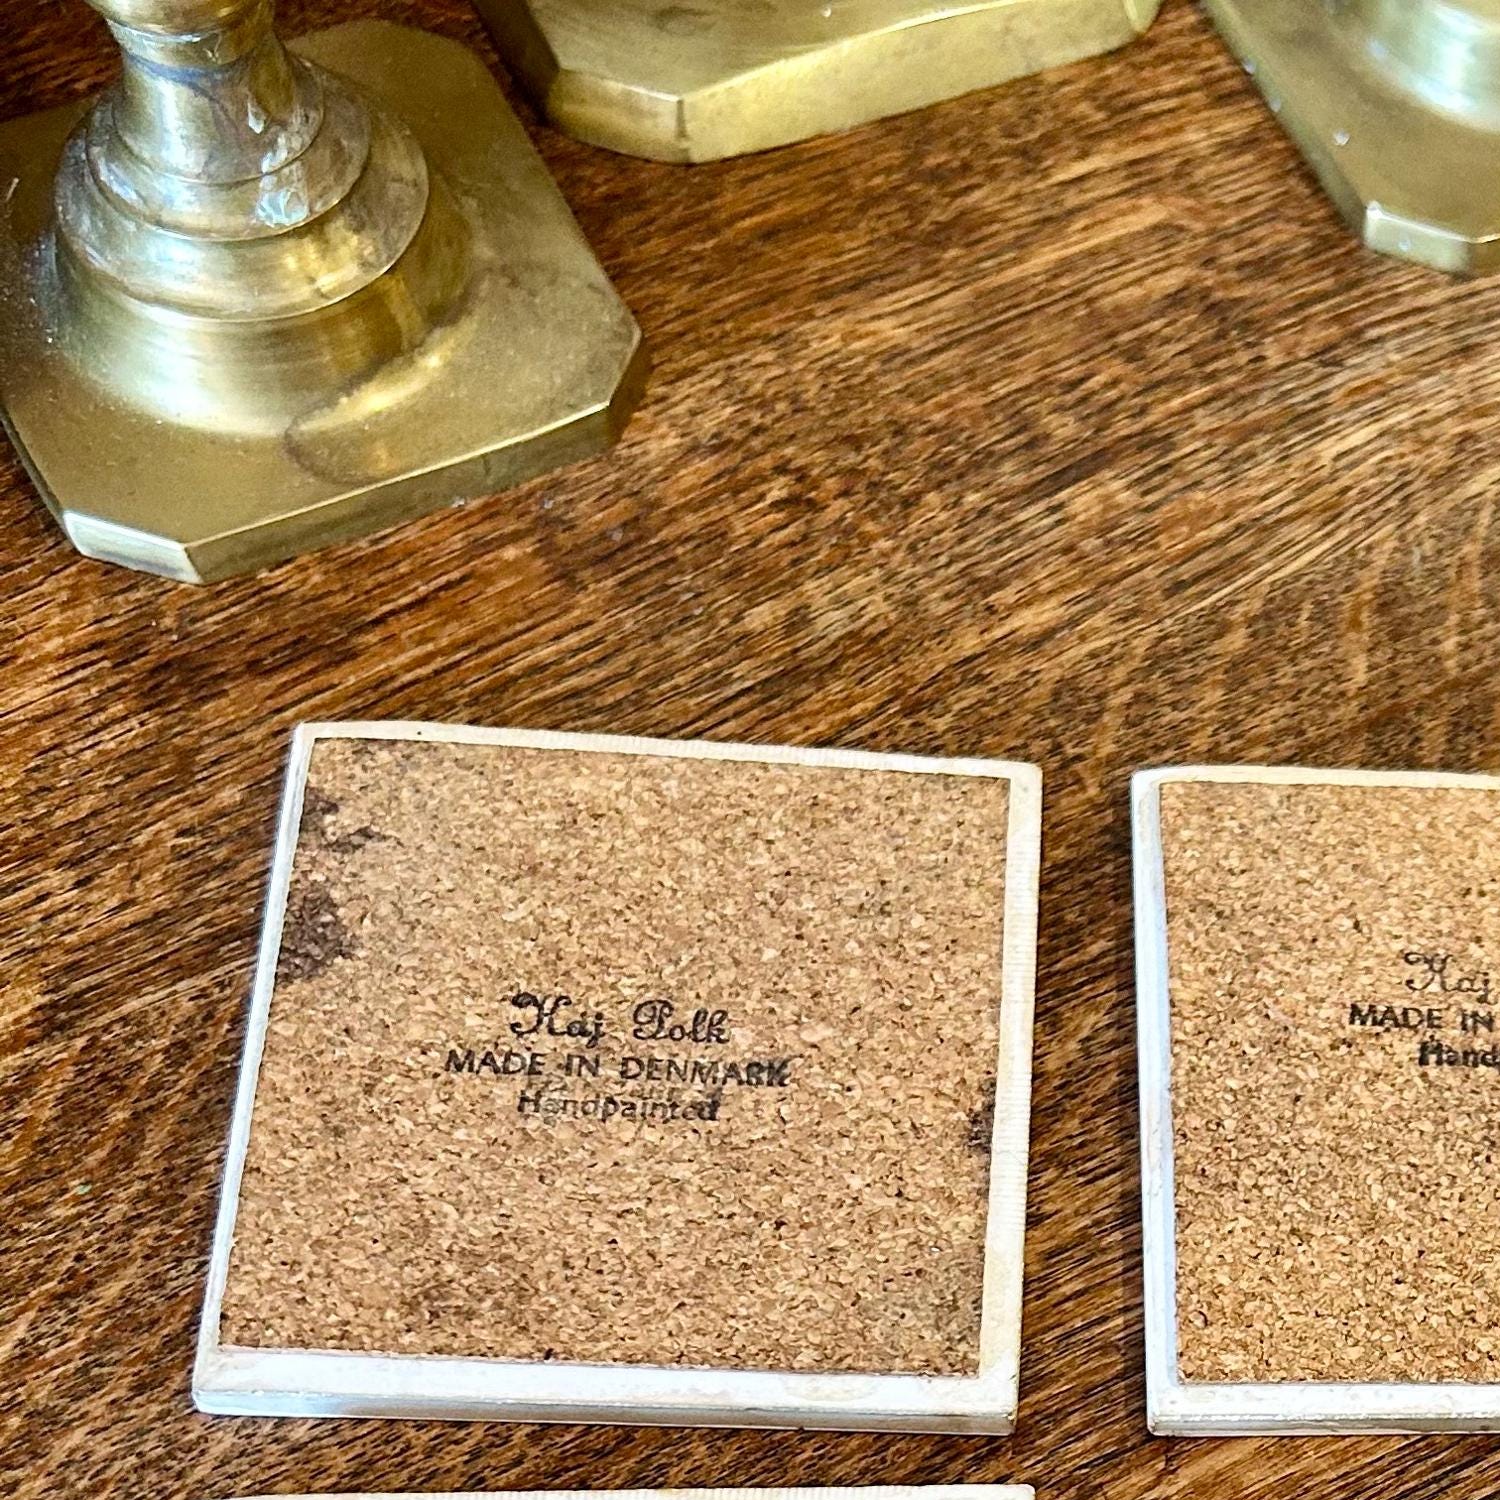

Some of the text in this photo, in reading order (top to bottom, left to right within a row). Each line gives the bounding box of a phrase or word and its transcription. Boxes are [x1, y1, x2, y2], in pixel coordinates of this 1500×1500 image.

[1404, 951, 1498, 1004] Kaj
[510, 992, 730, 1048] Kaj Polk
[1349, 1004, 1442, 1029] MADE
[1460, 1011, 1494, 1033] IN
[444, 1049, 792, 1087] MADE IN DENMARK
[517, 1089, 721, 1122] Handpainted
